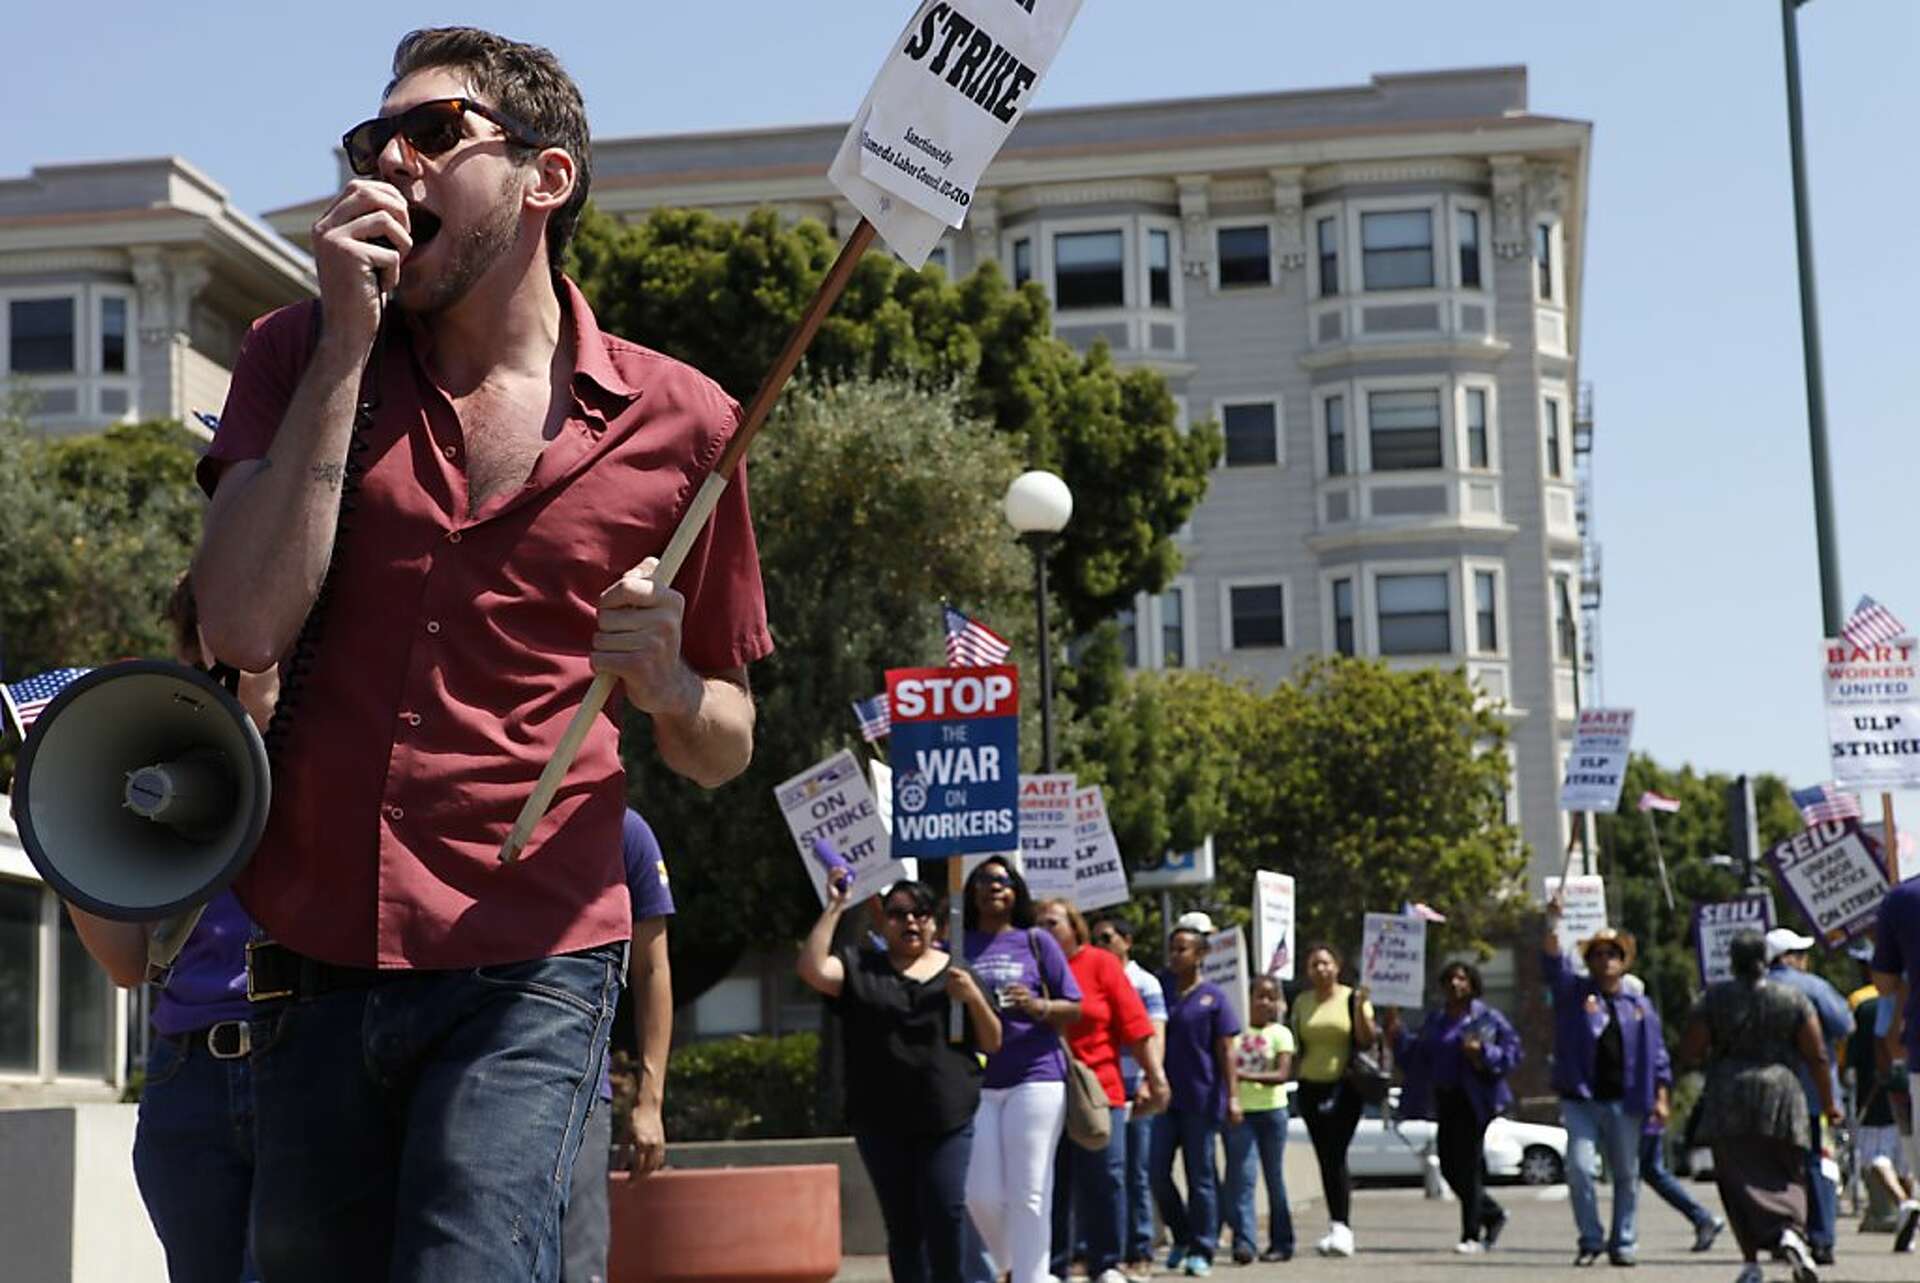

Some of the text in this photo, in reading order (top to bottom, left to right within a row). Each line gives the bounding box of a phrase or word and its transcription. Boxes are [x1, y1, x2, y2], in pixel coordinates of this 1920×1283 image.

[904, 2, 1036, 124] STRIKE
[893, 151, 918, 177] Labor
[1827, 644, 1912, 663] BART
[1828, 667, 1914, 679] WORKERS
[896, 675, 1013, 717] STOP
[1839, 682, 1908, 696] UNITED
[942, 725, 968, 742] THE
[1854, 716, 1901, 730] ULP
[916, 745, 1000, 785] WAR
[945, 789, 967, 806] ON
[1024, 782, 1070, 795] ART
[811, 791, 846, 820] ON
[1020, 811, 1065, 821] NITED
[800, 800, 875, 850] STRIKE
[897, 808, 1013, 842] WORKERS
[841, 837, 877, 865] ART
[1076, 845, 1099, 860] LP
[1775, 820, 1846, 871] SEIU
[1023, 857, 1069, 869] RIKE
[1076, 861, 1118, 880] RIKE
[1801, 847, 1847, 877] UNFAIR
[1811, 861, 1853, 889] LABOR
[1811, 868, 1868, 904] PRACTICE
[1700, 901, 1761, 923] SEIU
[1818, 907, 1842, 927] ON
[1840, 881, 1886, 916] STRIKE
